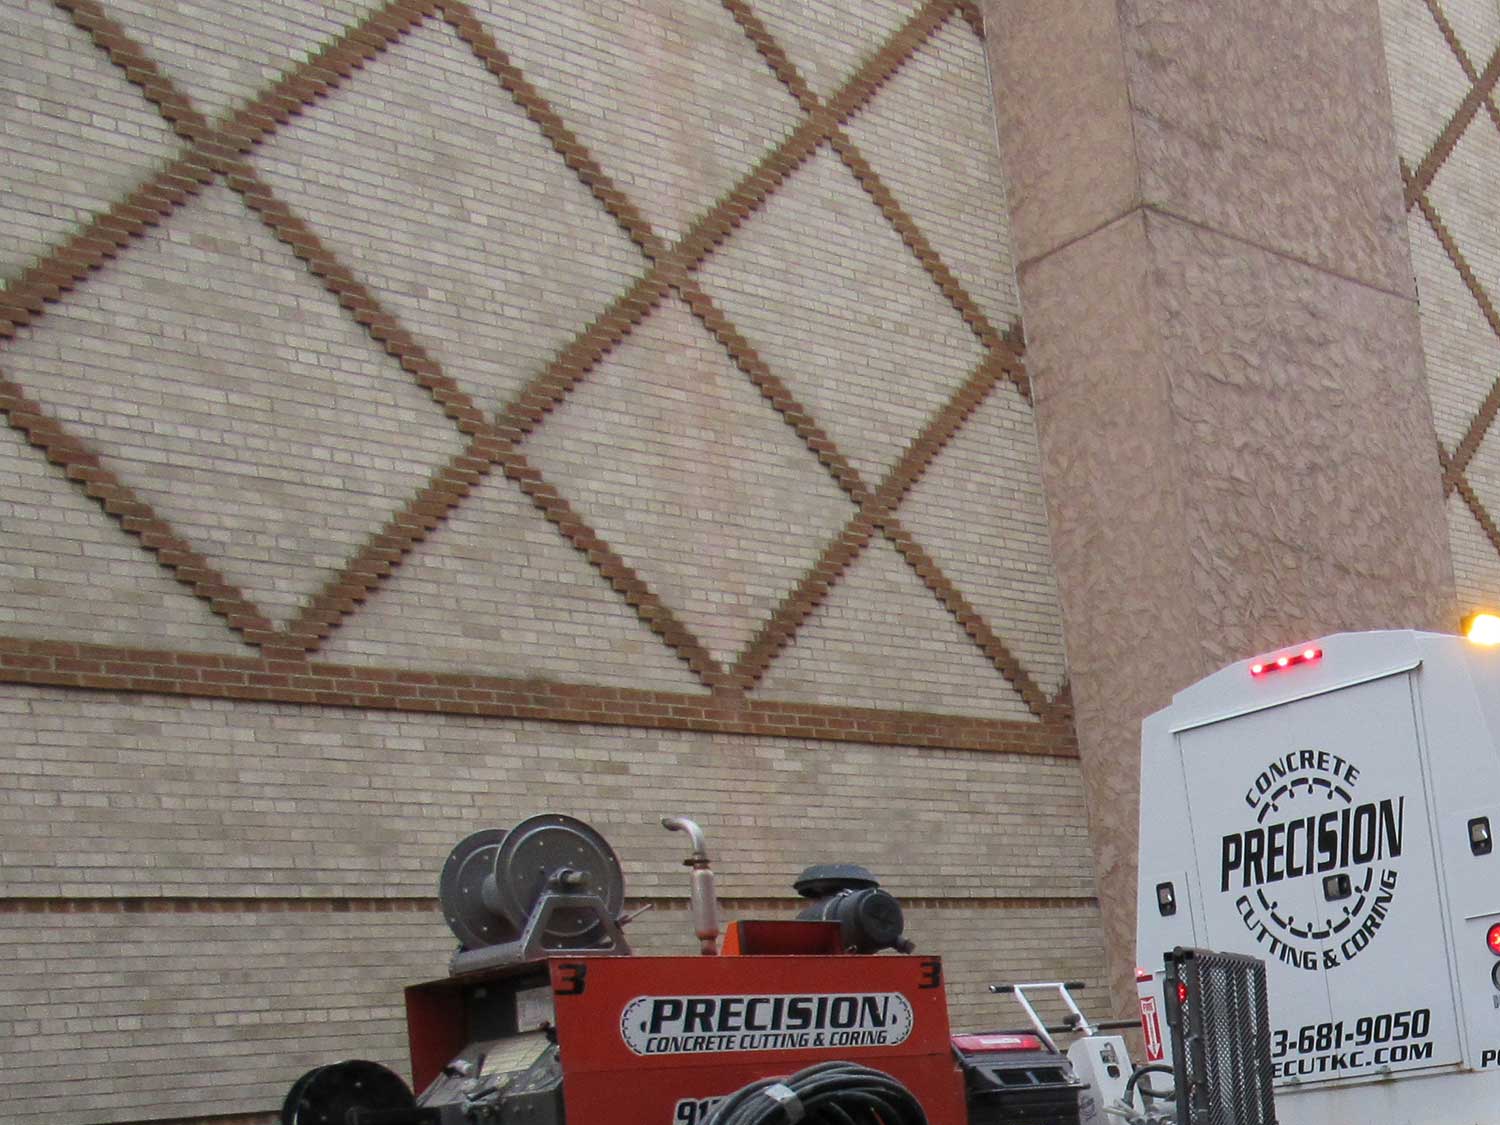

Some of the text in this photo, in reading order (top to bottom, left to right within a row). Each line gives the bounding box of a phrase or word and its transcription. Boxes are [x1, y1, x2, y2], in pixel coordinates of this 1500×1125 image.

[1245, 750, 1360, 808] CONCRETE
[1221, 796, 1404, 892] PRECISION
[1236, 868, 1398, 970] CUTTING & CORING
[555, 963, 588, 996] 3
[918, 962, 942, 989] 3
[649, 996, 890, 1034] PRECISION
[1272, 1008, 1431, 1058] 3-681-9050
[645, 1030, 888, 1053] CONCRETE CUTTING & CORING
[1272, 1042, 1434, 1079] ECUTKC.COM
